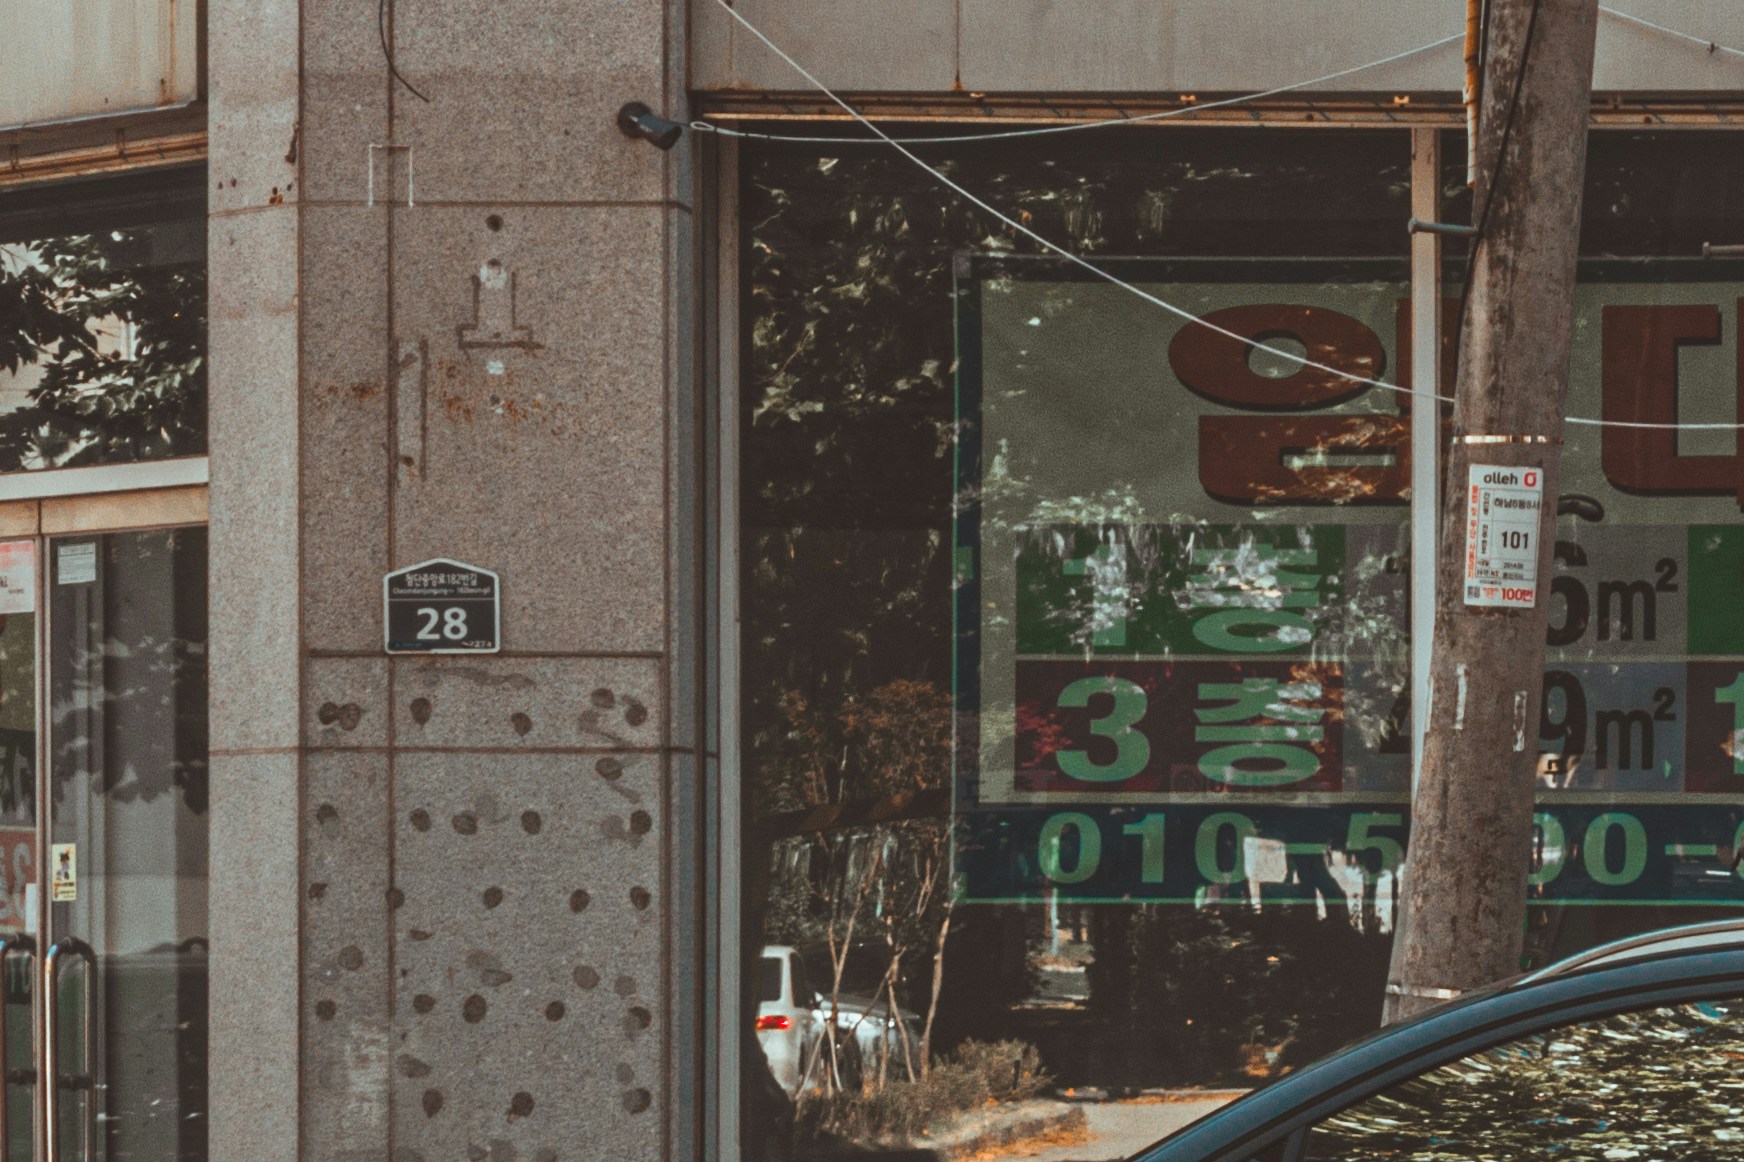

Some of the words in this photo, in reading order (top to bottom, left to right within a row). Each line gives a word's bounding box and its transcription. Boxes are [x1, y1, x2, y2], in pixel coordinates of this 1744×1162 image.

[1483, 471, 1518, 485] olleh
[1502, 531, 1529, 549] 101
[416, 607, 468, 640] 28
